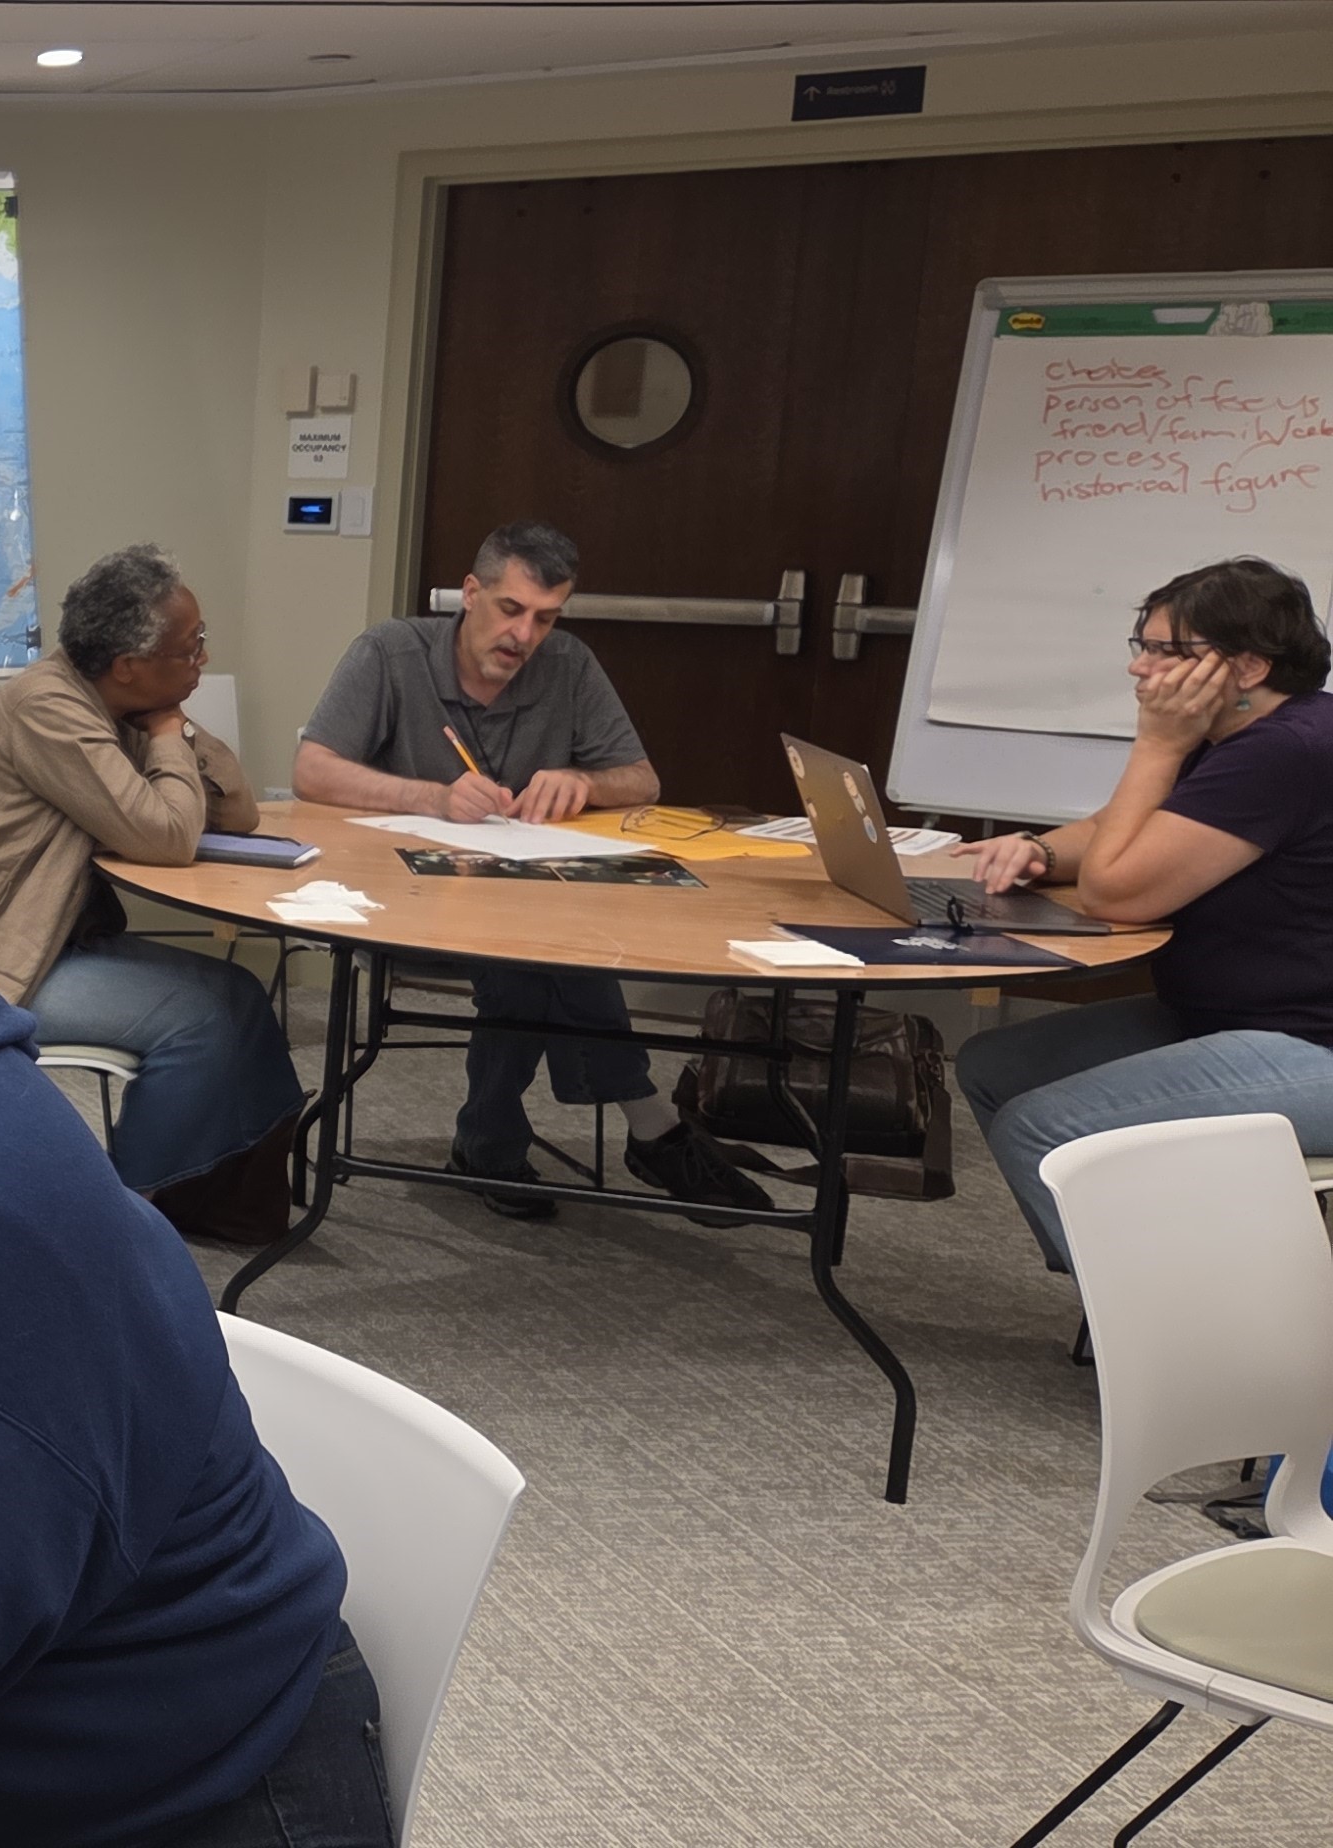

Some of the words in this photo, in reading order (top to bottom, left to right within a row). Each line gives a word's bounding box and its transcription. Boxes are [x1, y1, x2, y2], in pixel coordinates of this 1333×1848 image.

[1043, 393, 1143, 424] person
[291, 444, 347, 453] OCCUPANCY
[1034, 450, 1190, 482] process
[1201, 460, 1320, 514] figure
